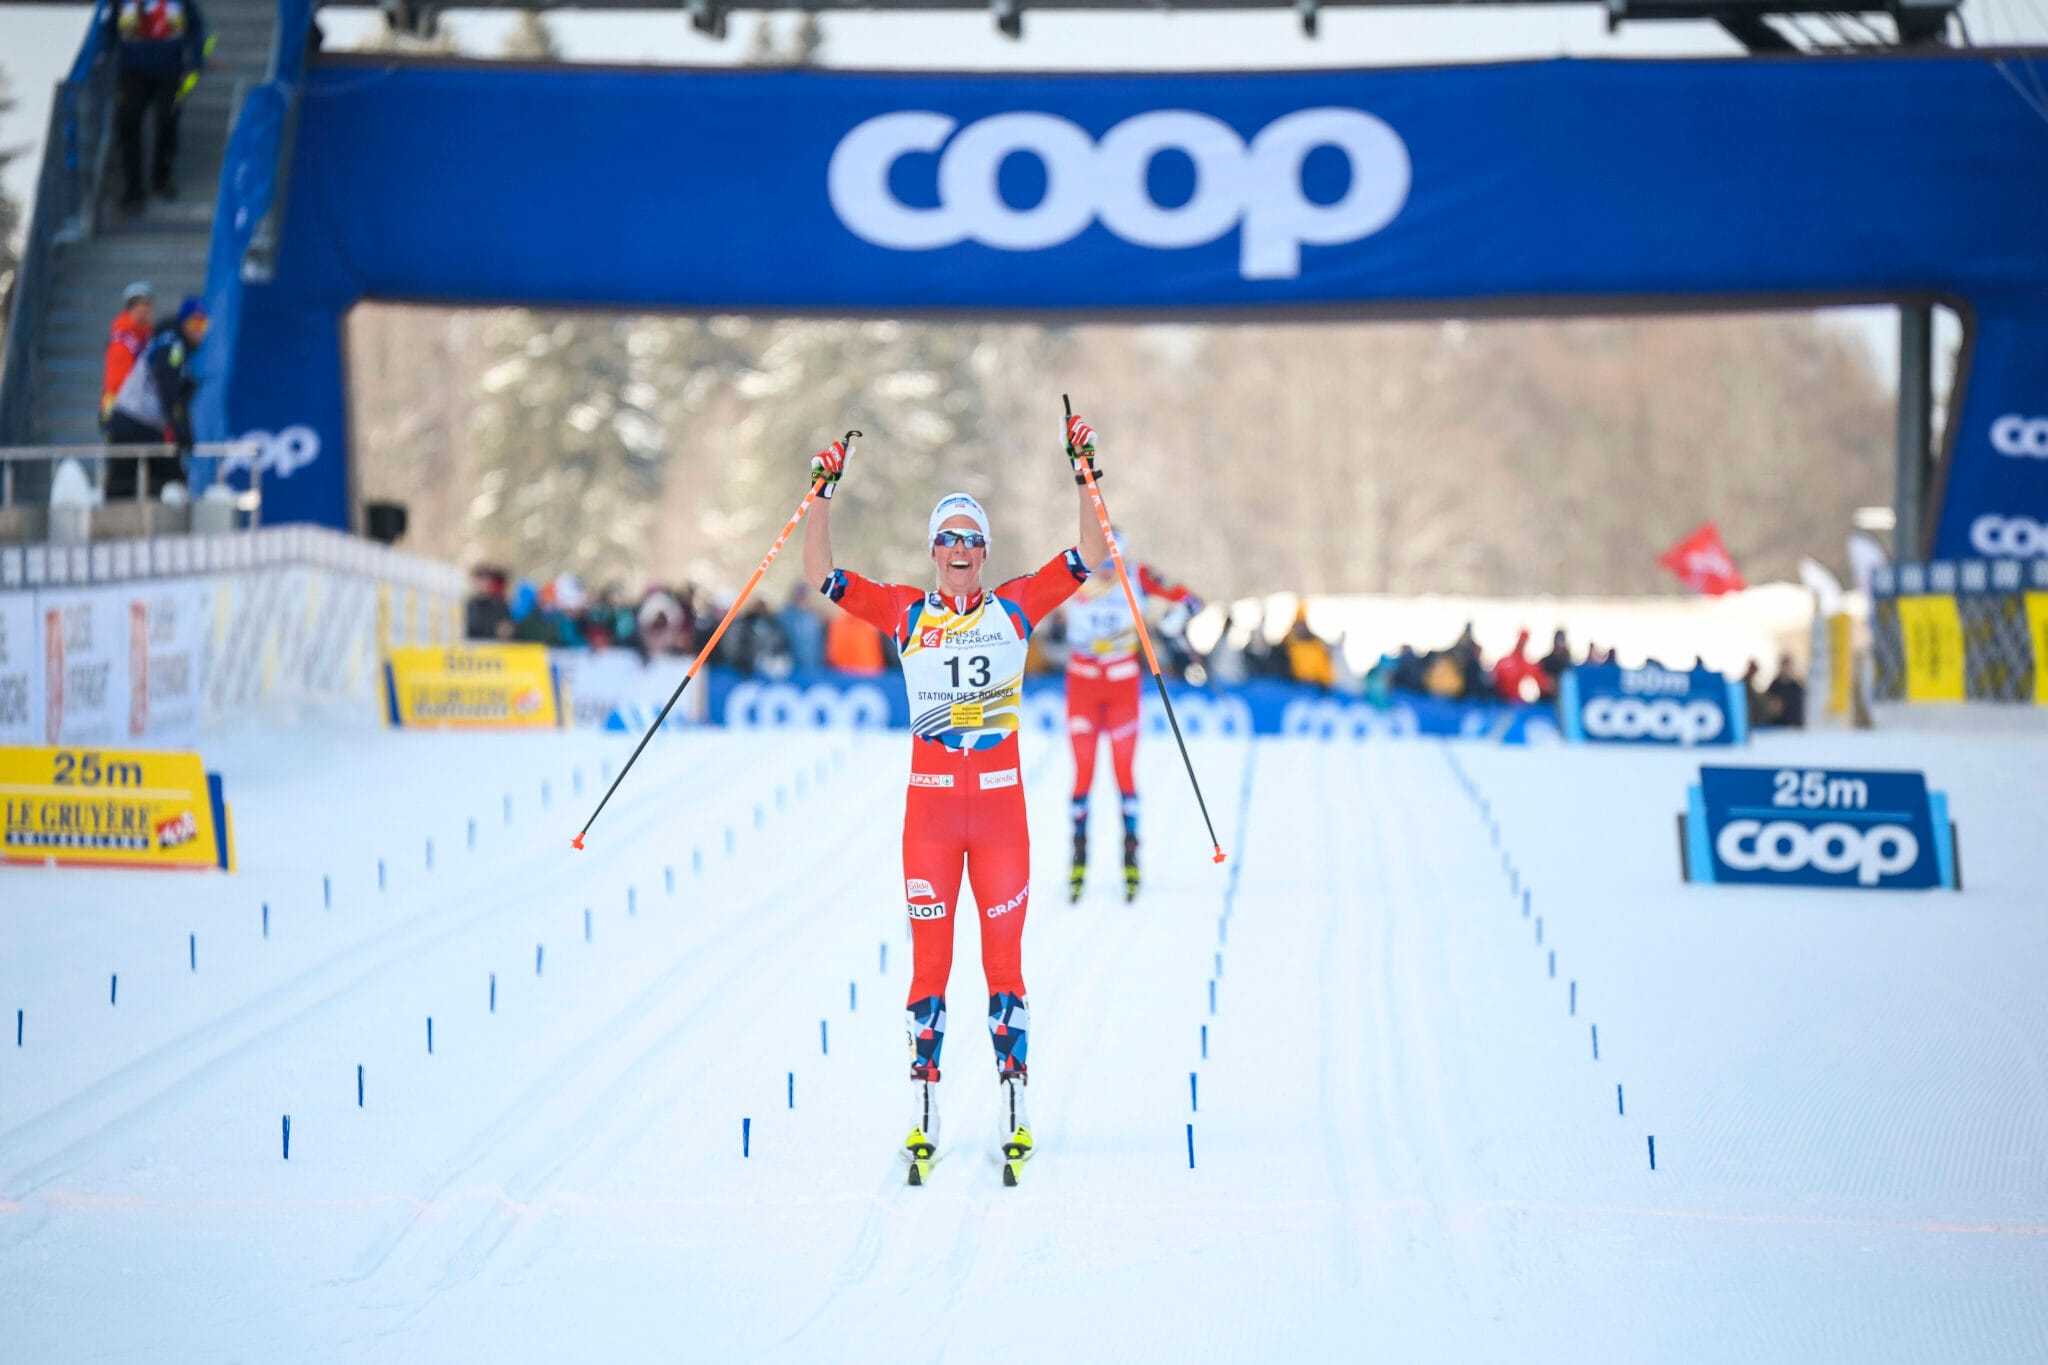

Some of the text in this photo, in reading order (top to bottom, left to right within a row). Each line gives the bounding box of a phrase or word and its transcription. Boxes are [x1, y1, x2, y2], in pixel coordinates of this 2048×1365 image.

[827, 107, 1412, 280] coop
[758, 535, 786, 571] ONE
[946, 627, 980, 639] CAISSE
[944, 656, 991, 688] 13
[917, 687, 1014, 701] STATION DES ROUSSES
[1583, 697, 1725, 745] coop
[54, 752, 142, 785] 25m
[984, 774, 1015, 785] Scandic
[1773, 770, 1867, 809] 25m
[6, 801, 33, 826] LE
[1716, 819, 1919, 885] coop
